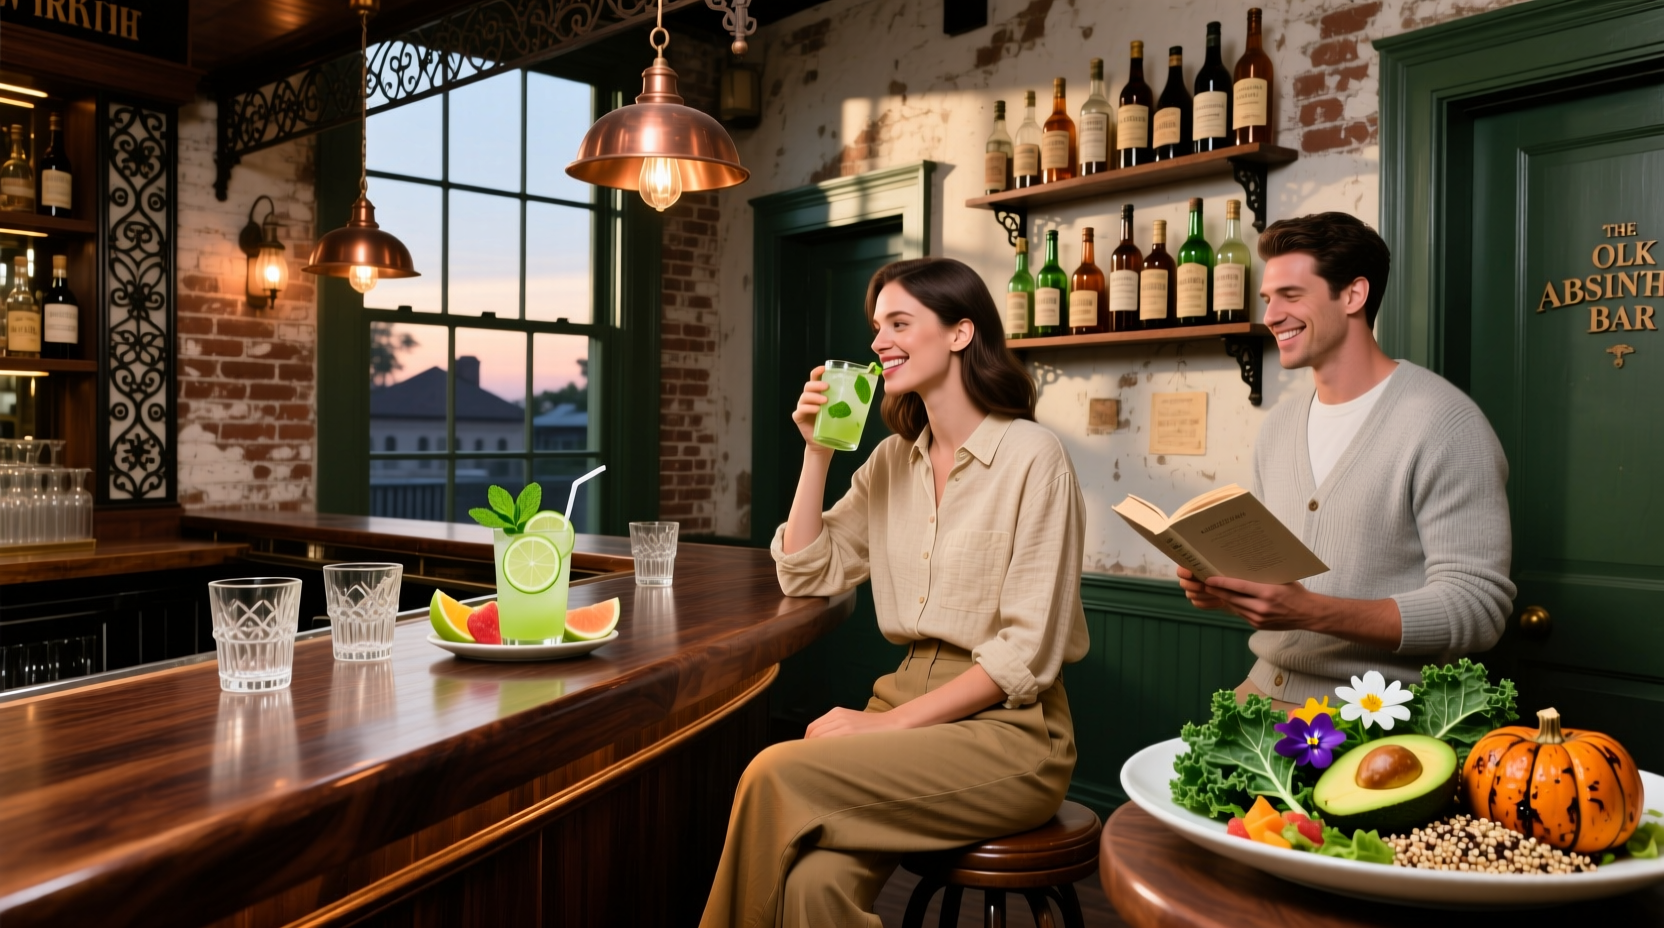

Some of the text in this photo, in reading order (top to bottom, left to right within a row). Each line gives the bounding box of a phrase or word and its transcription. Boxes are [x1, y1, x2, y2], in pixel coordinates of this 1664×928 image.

[1602, 222, 1637, 238] THE
[1592, 240, 1657, 269] OLK
[1587, 305, 1657, 334] BAR
